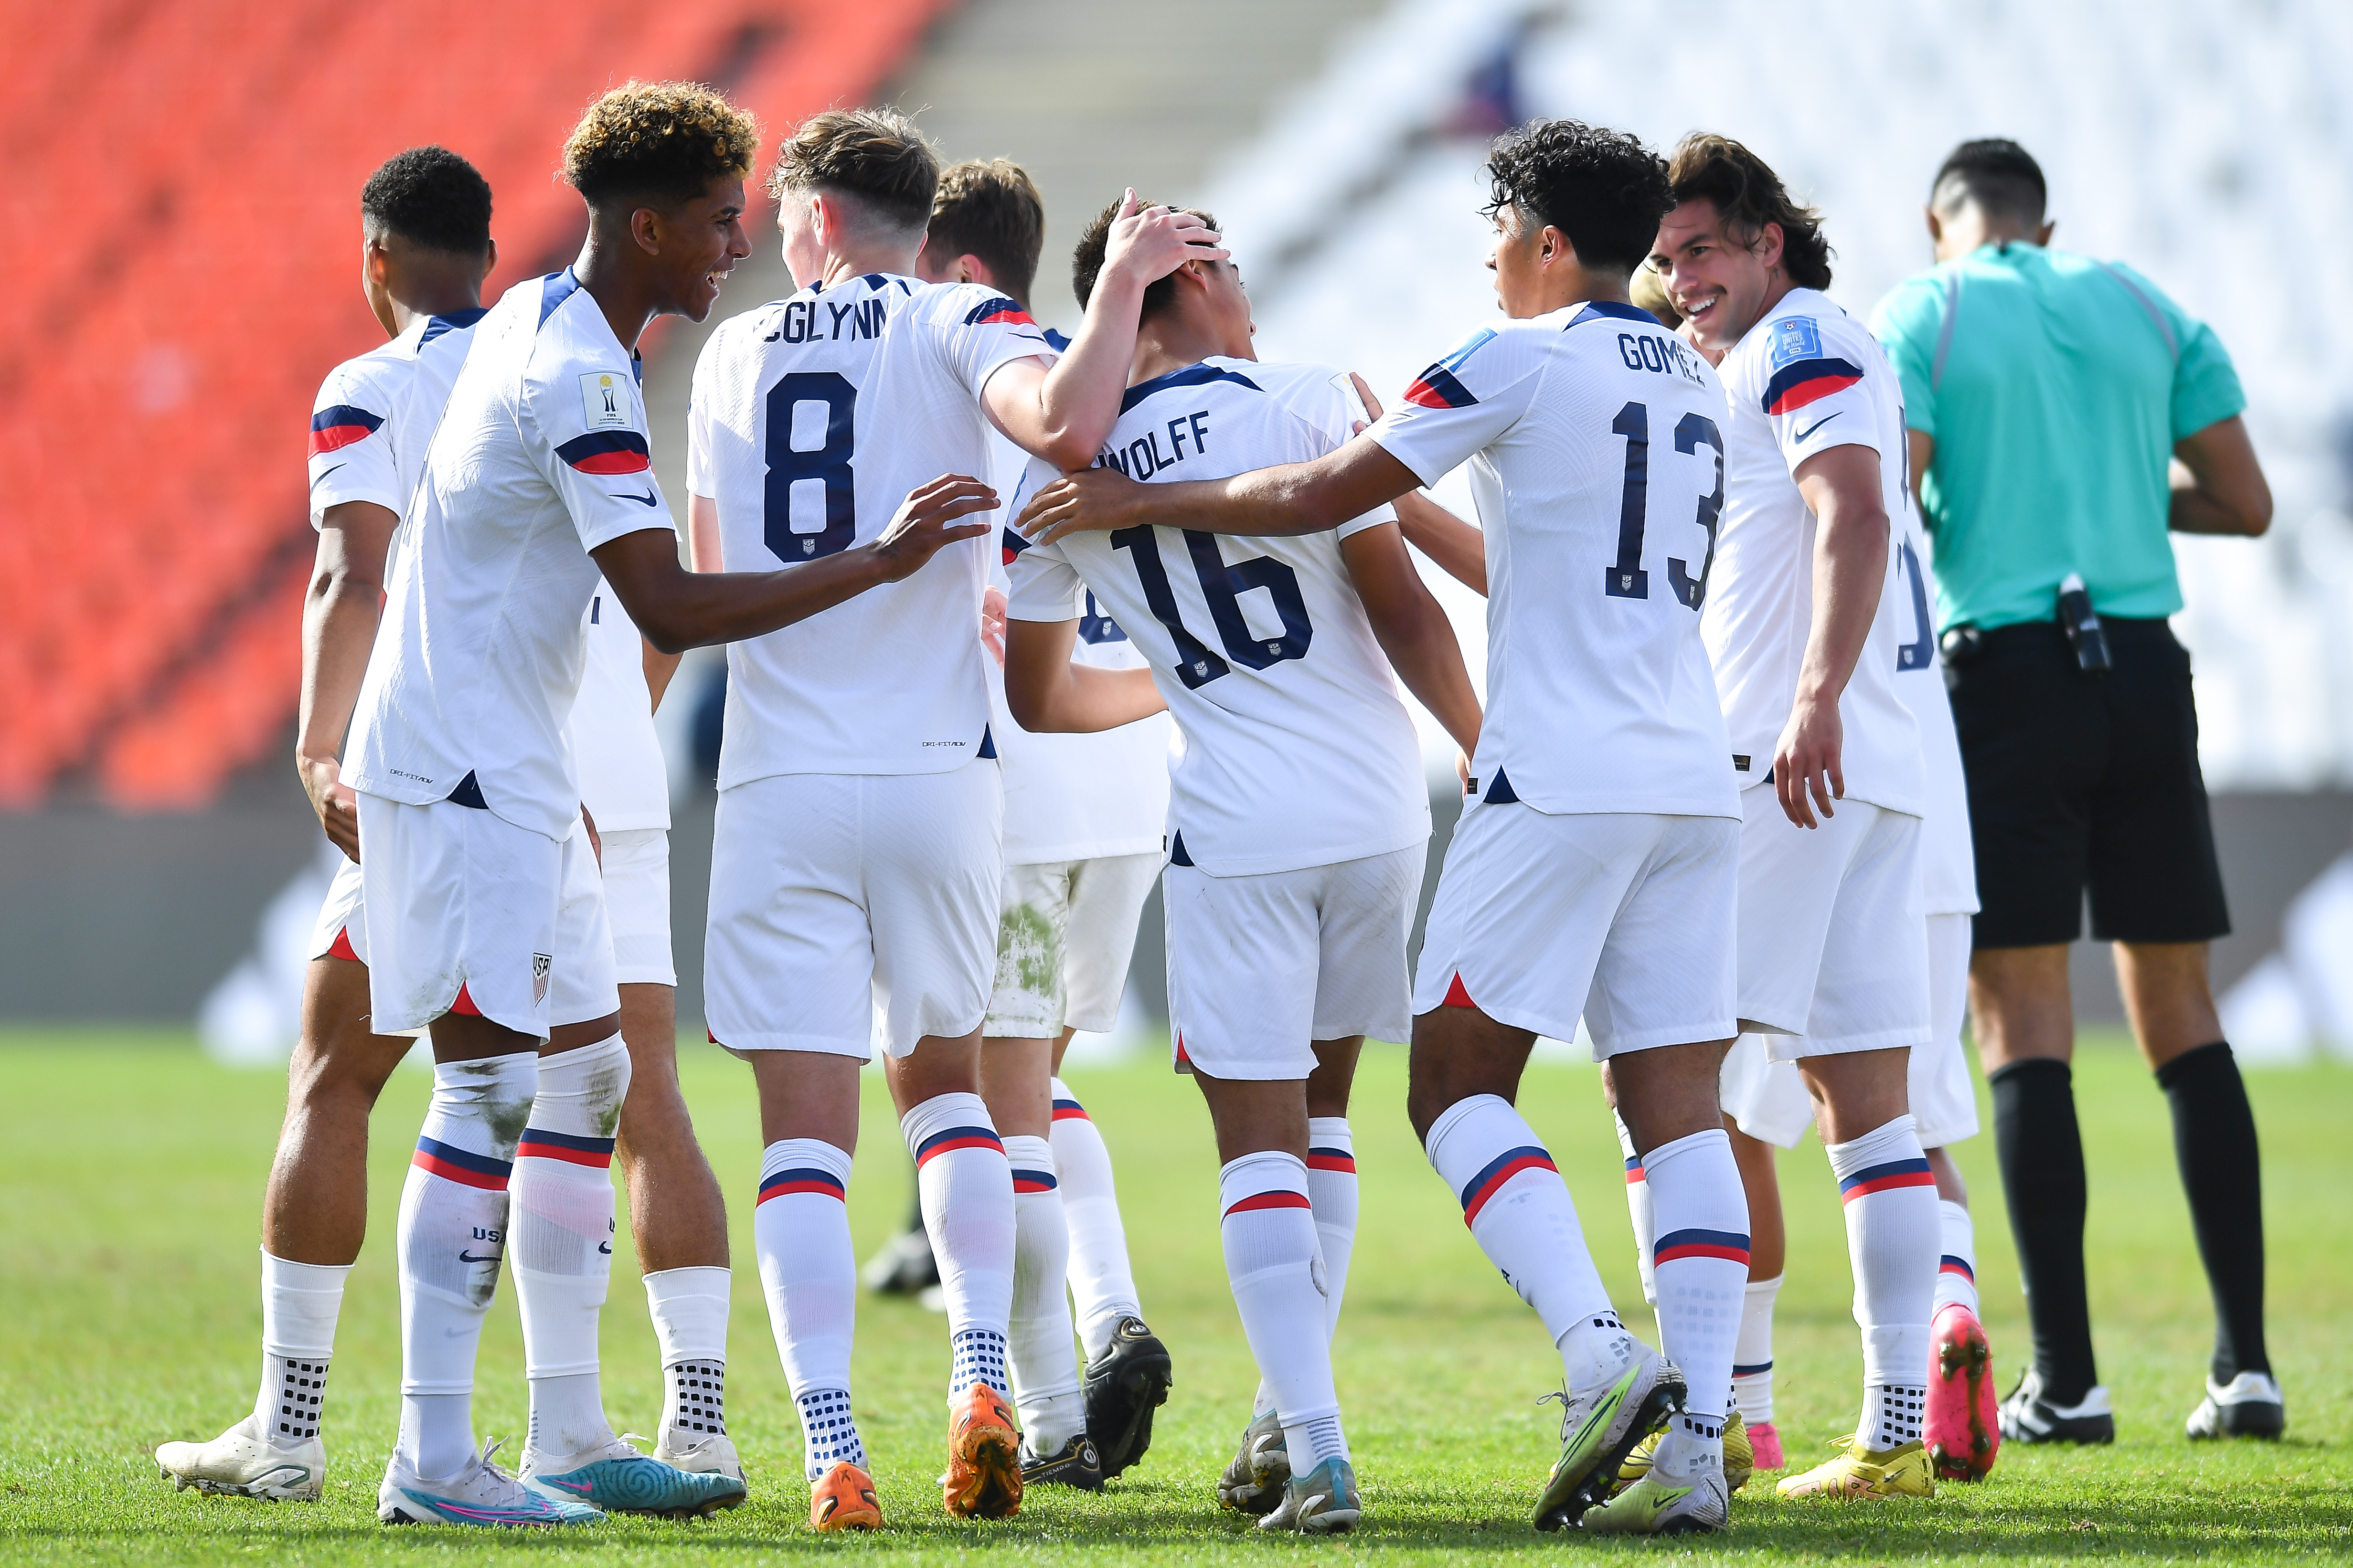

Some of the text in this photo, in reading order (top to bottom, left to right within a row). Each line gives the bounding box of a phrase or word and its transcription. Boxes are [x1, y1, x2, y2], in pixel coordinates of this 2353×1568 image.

[764, 298, 887, 344] GLYNN
[1783, 335, 1803, 345] UNITES
[764, 371, 858, 563] 8
[1606, 401, 1725, 613] 13
[1108, 523, 1314, 690] 16
[533, 956, 550, 976] USA
[473, 1227, 504, 1243] US
[1042, 1463, 1070, 1478] TIEMPO
